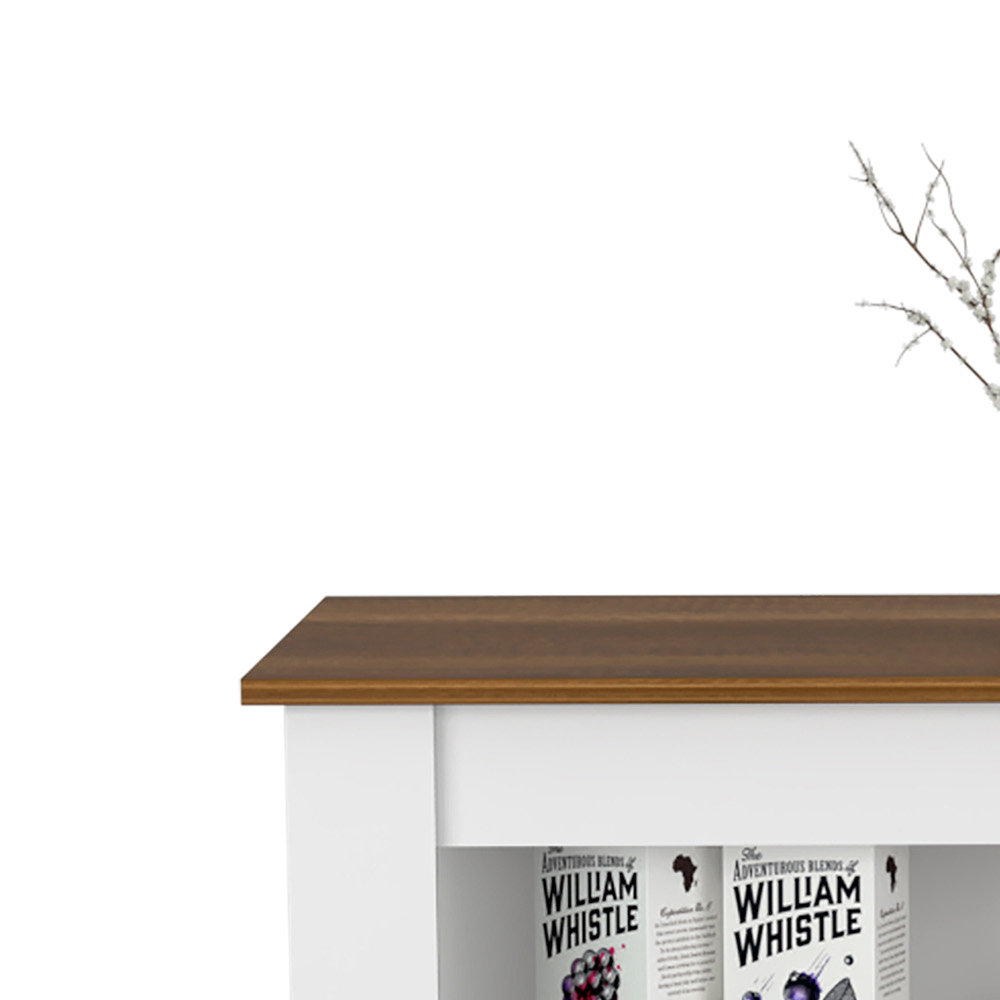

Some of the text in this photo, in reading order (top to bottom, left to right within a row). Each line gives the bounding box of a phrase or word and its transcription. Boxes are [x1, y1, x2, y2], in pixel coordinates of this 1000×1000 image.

[541, 871, 638, 916] WILLIAM
[733, 860, 806, 882] ADVENTUROUS
[808, 860, 844, 872] BLENDS
[733, 875, 861, 924] WILLIAM
[542, 904, 639, 959] WHISTLE
[734, 908, 862, 968] WHISTLE
